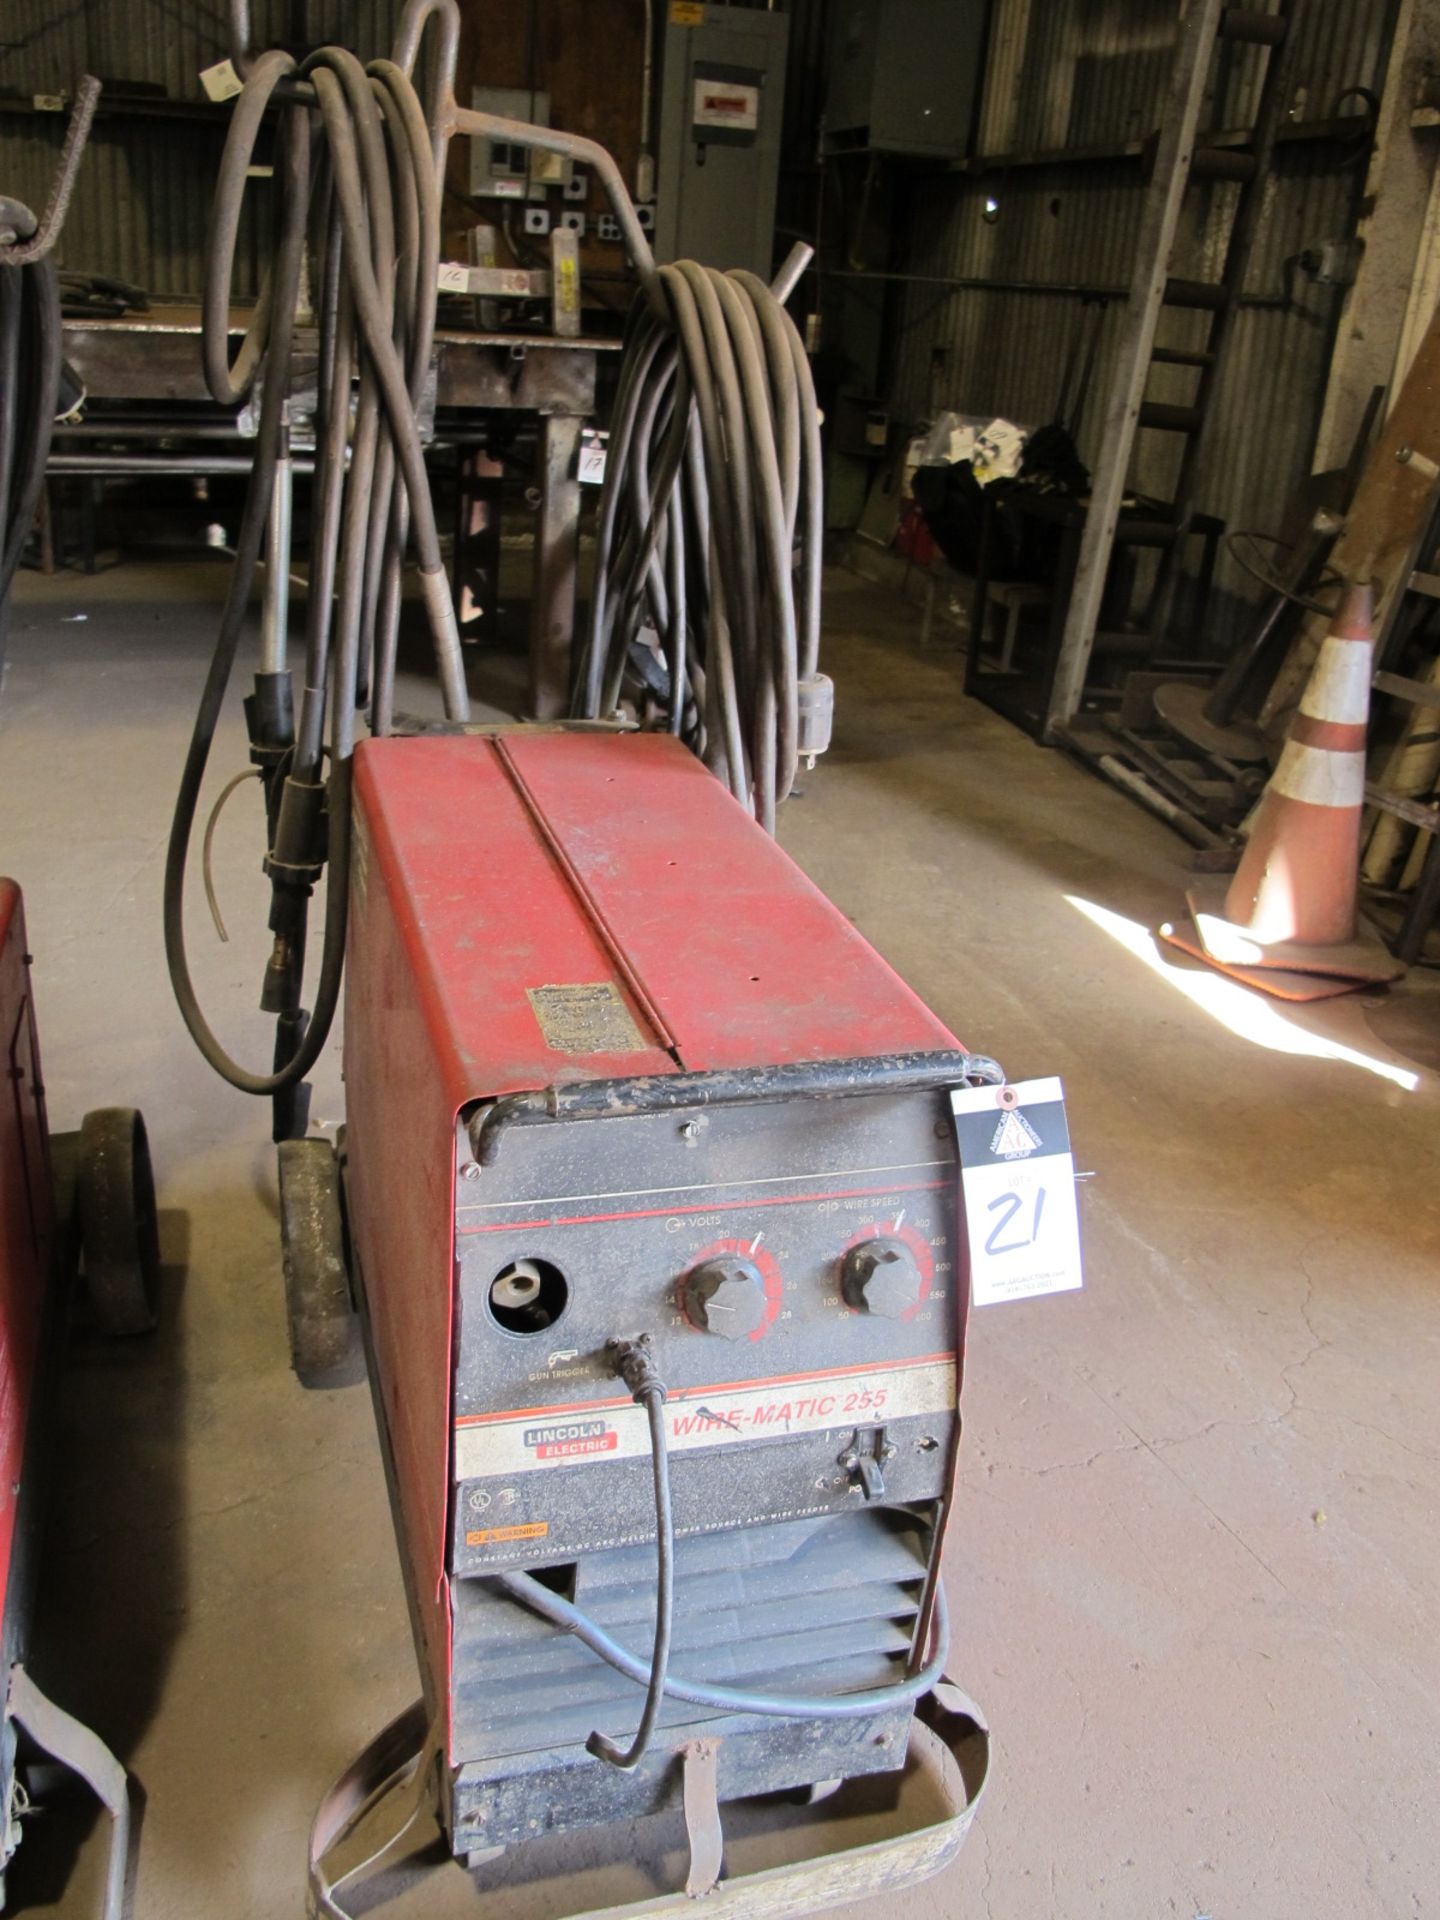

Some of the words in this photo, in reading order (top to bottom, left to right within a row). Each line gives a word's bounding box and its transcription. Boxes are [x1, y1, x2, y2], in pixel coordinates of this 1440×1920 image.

[990, 1111, 1009, 1153] AMERICAN
[1005, 1149, 1032, 1160] GROUP
[844, 1199, 869, 1210] WIRE
[870, 1196, 900, 1208] SPEED
[688, 1216, 721, 1227] VOLTS
[985, 1187, 1047, 1256] 21
[718, 1230, 730, 1239] 20
[665, 1295, 676, 1304] 14
[823, 1297, 839, 1307] 100
[670, 1316, 683, 1326] 12
[781, 1311, 793, 1320] 28
[528, 1370, 550, 1382] GUN
[552, 1367, 590, 1380] TRIGGER
[672, 1396, 836, 1437] WIRE-MATIC
[842, 1389, 888, 1412] 255
[526, 1423, 602, 1445] LINCOLN
[546, 1440, 609, 1456] ELECTRIC
[501, 1525, 545, 1538] WARNING
[620, 1532, 656, 1545] WELDIN
[674, 1524, 700, 1535] OWER
[746, 1514, 766, 1523] AND
[770, 1510, 792, 1519] WIRE
